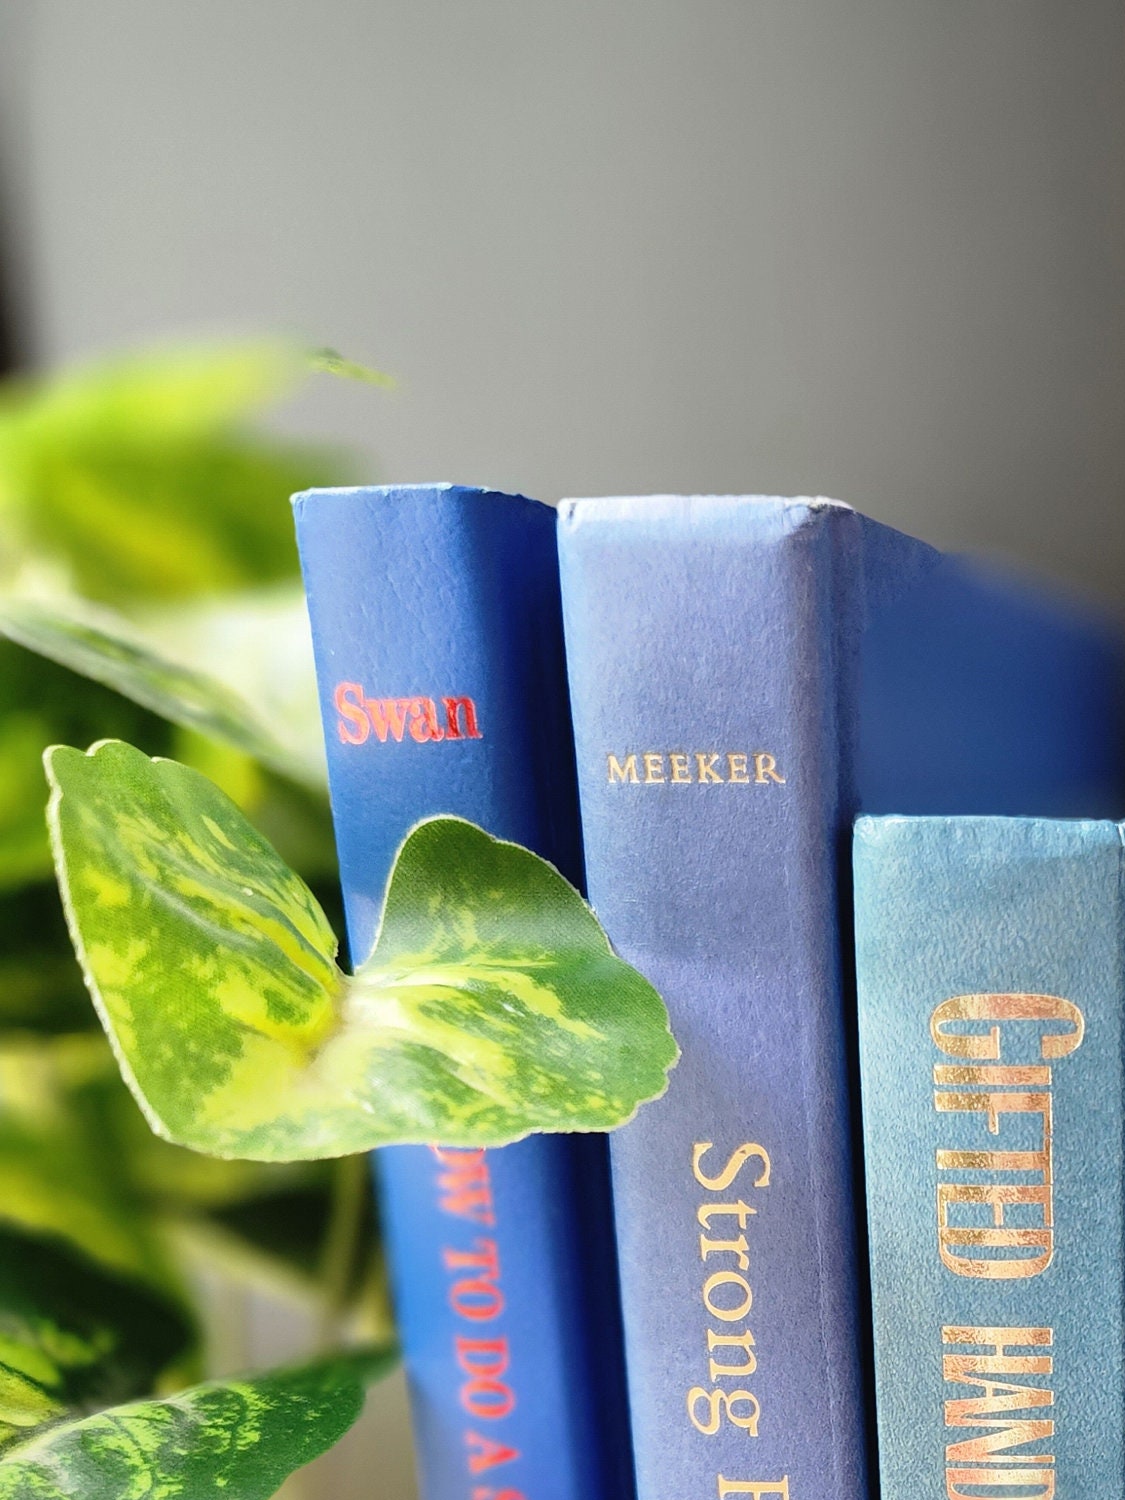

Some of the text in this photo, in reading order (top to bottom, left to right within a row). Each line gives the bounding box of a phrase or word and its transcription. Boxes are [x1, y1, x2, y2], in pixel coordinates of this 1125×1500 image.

[334, 681, 483, 744] Swan
[607, 753, 786, 785] MEEKER
[930, 993, 1085, 1280] GIFTED
[442, 1237, 506, 1323] TO
[686, 1142, 772, 1437] Strong
[454, 1335, 517, 1420] DO
[463, 1430, 520, 1476] A
